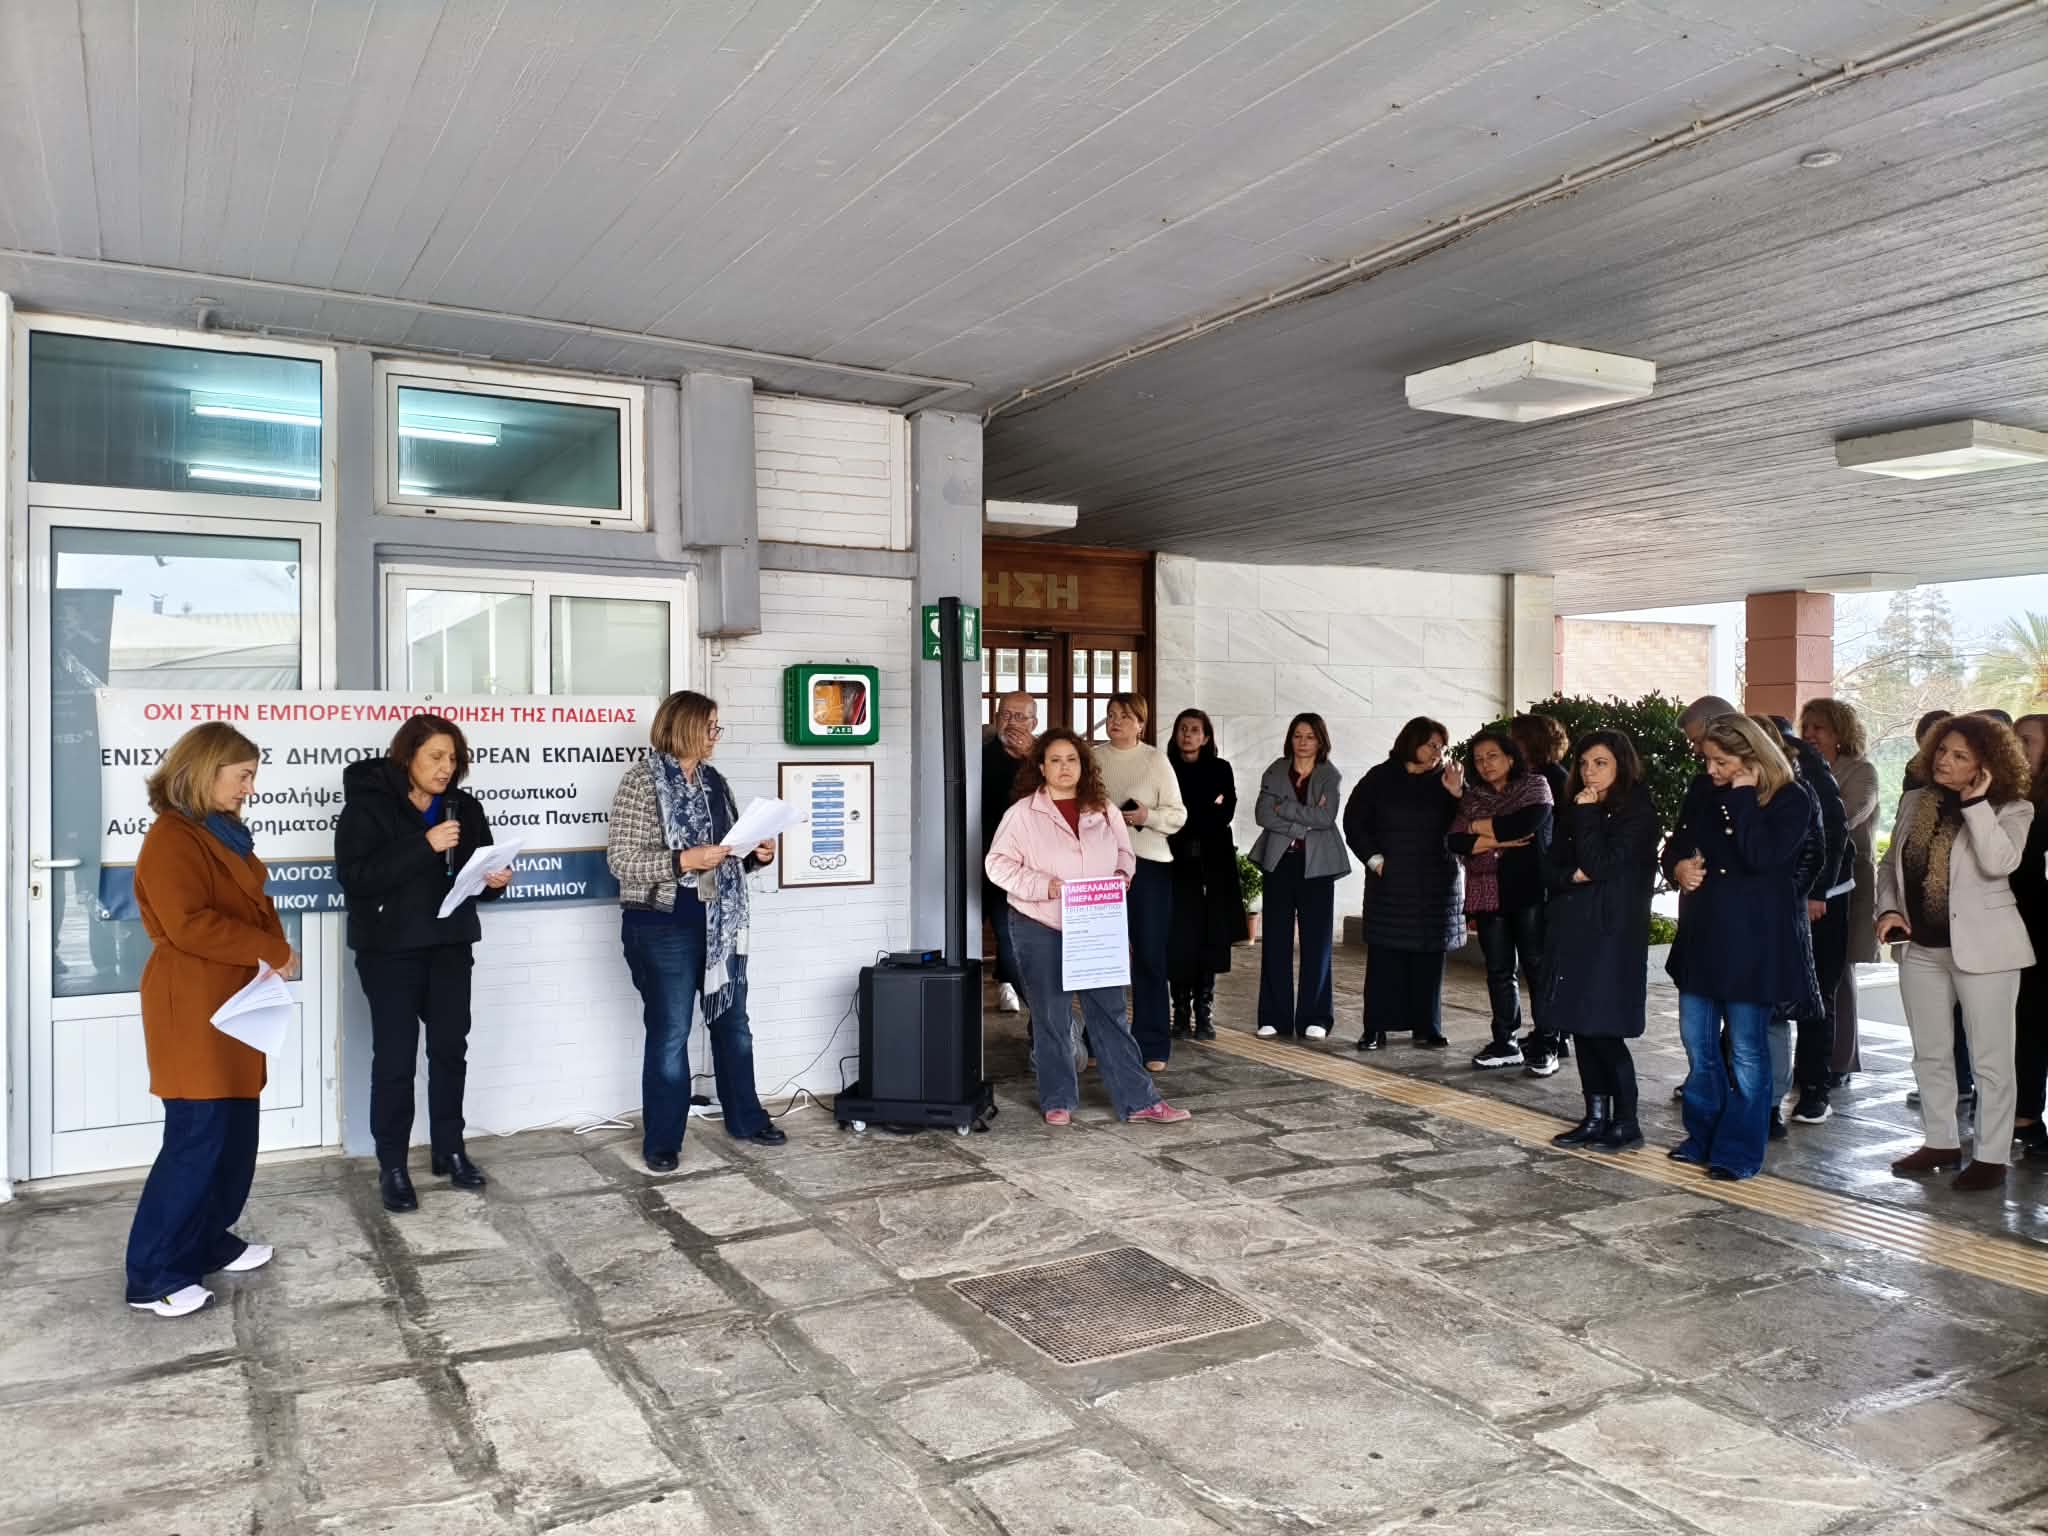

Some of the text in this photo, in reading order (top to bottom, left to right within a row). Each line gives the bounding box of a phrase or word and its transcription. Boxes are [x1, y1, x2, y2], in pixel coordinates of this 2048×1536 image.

[982, 571, 1079, 608] ΗΣΗ
[143, 703, 637, 723] ΟΧΙ ΣΤΗΝ ΕΜΠΟΡΕΥΜΑΤΟΠΟΙΗΣΗ ΤΗΣ ΠΑΙΔΕΙΑΣ
[101, 749, 169, 766] ΕΝΙΣΧ
[286, 747, 392, 765] ΔΗΜΟΣΙ
[464, 747, 530, 763] ΩΡΕΑΝ
[243, 787, 343, 808] ροσλήψε
[107, 810, 608, 836] Αύξ ρηματοδ μόσια Πανεπι
